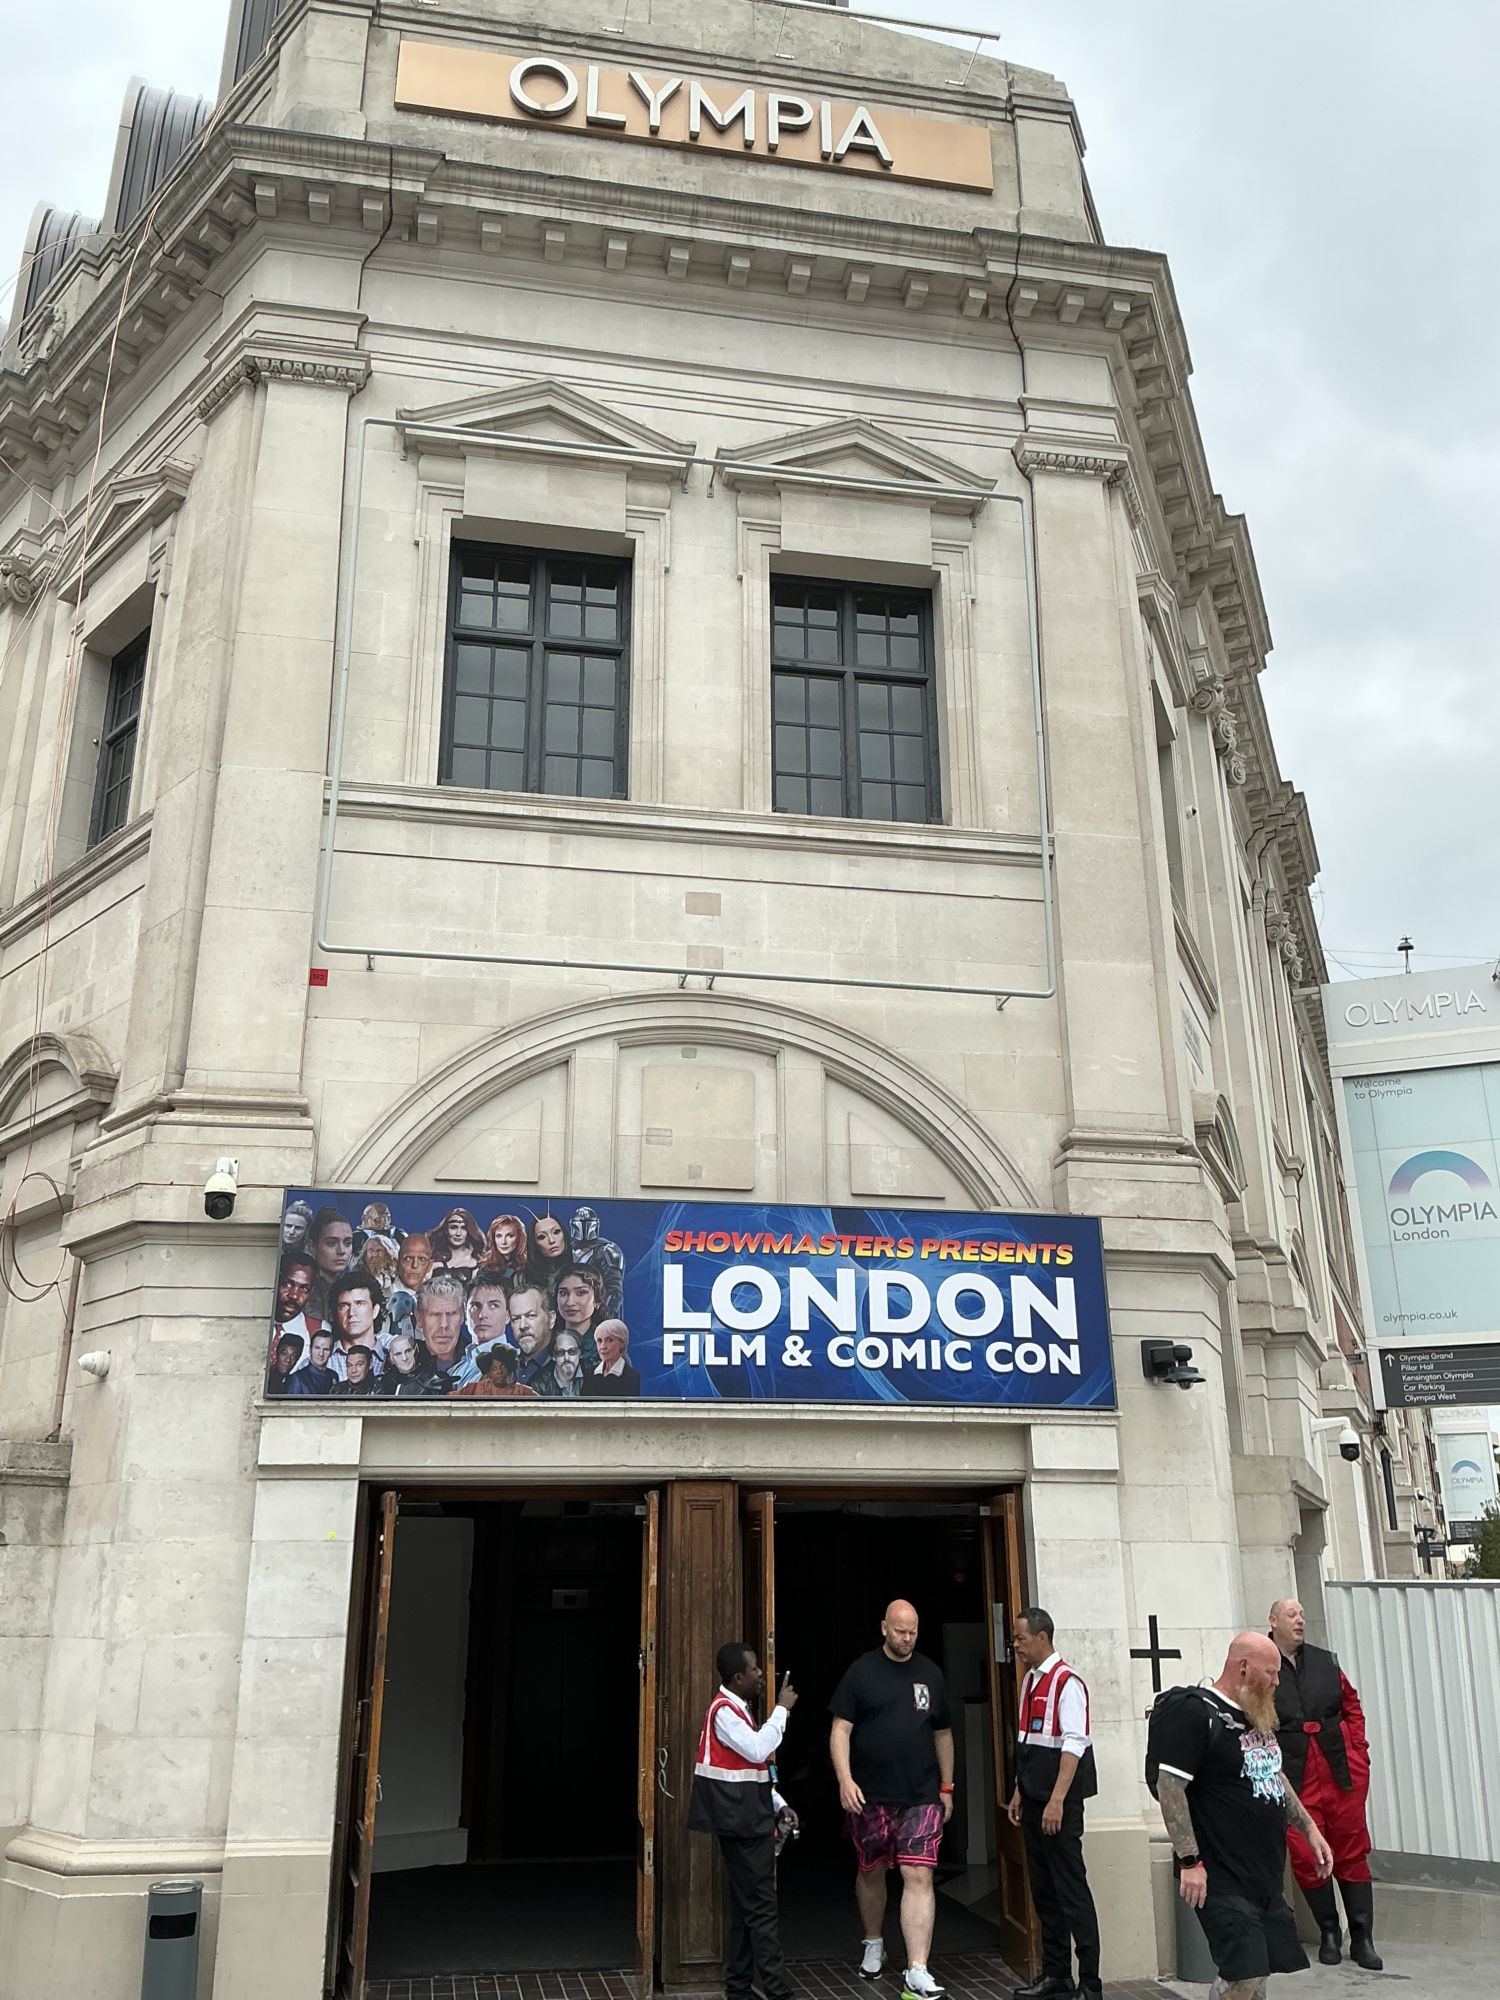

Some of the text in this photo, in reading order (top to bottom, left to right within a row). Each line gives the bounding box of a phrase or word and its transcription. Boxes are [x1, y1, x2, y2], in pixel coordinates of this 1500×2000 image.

[509, 57, 894, 169] OLYMPIA
[1345, 989, 1487, 1027] OLYMPIA
[1353, 1078, 1401, 1089] Welcome
[1368, 1087, 1413, 1100] Olympia
[1390, 1201, 1498, 1226] OLYMPIA
[1393, 1227, 1450, 1241] London
[663, 1231, 1074, 1265] SHOWMASTERS PRESENTS
[662, 1263, 1079, 1340] LONDON
[1383, 1309, 1458, 1324] olympia.co.uk
[662, 1333, 1082, 1376] FILM & COMIC CON
[1399, 1354, 1430, 1362] Olympia
[1402, 1372, 1473, 1382] Kensington Olympia
[1418, 1383, 1445, 1391] Parking
[1404, 1394, 1436, 1402] Olympia
